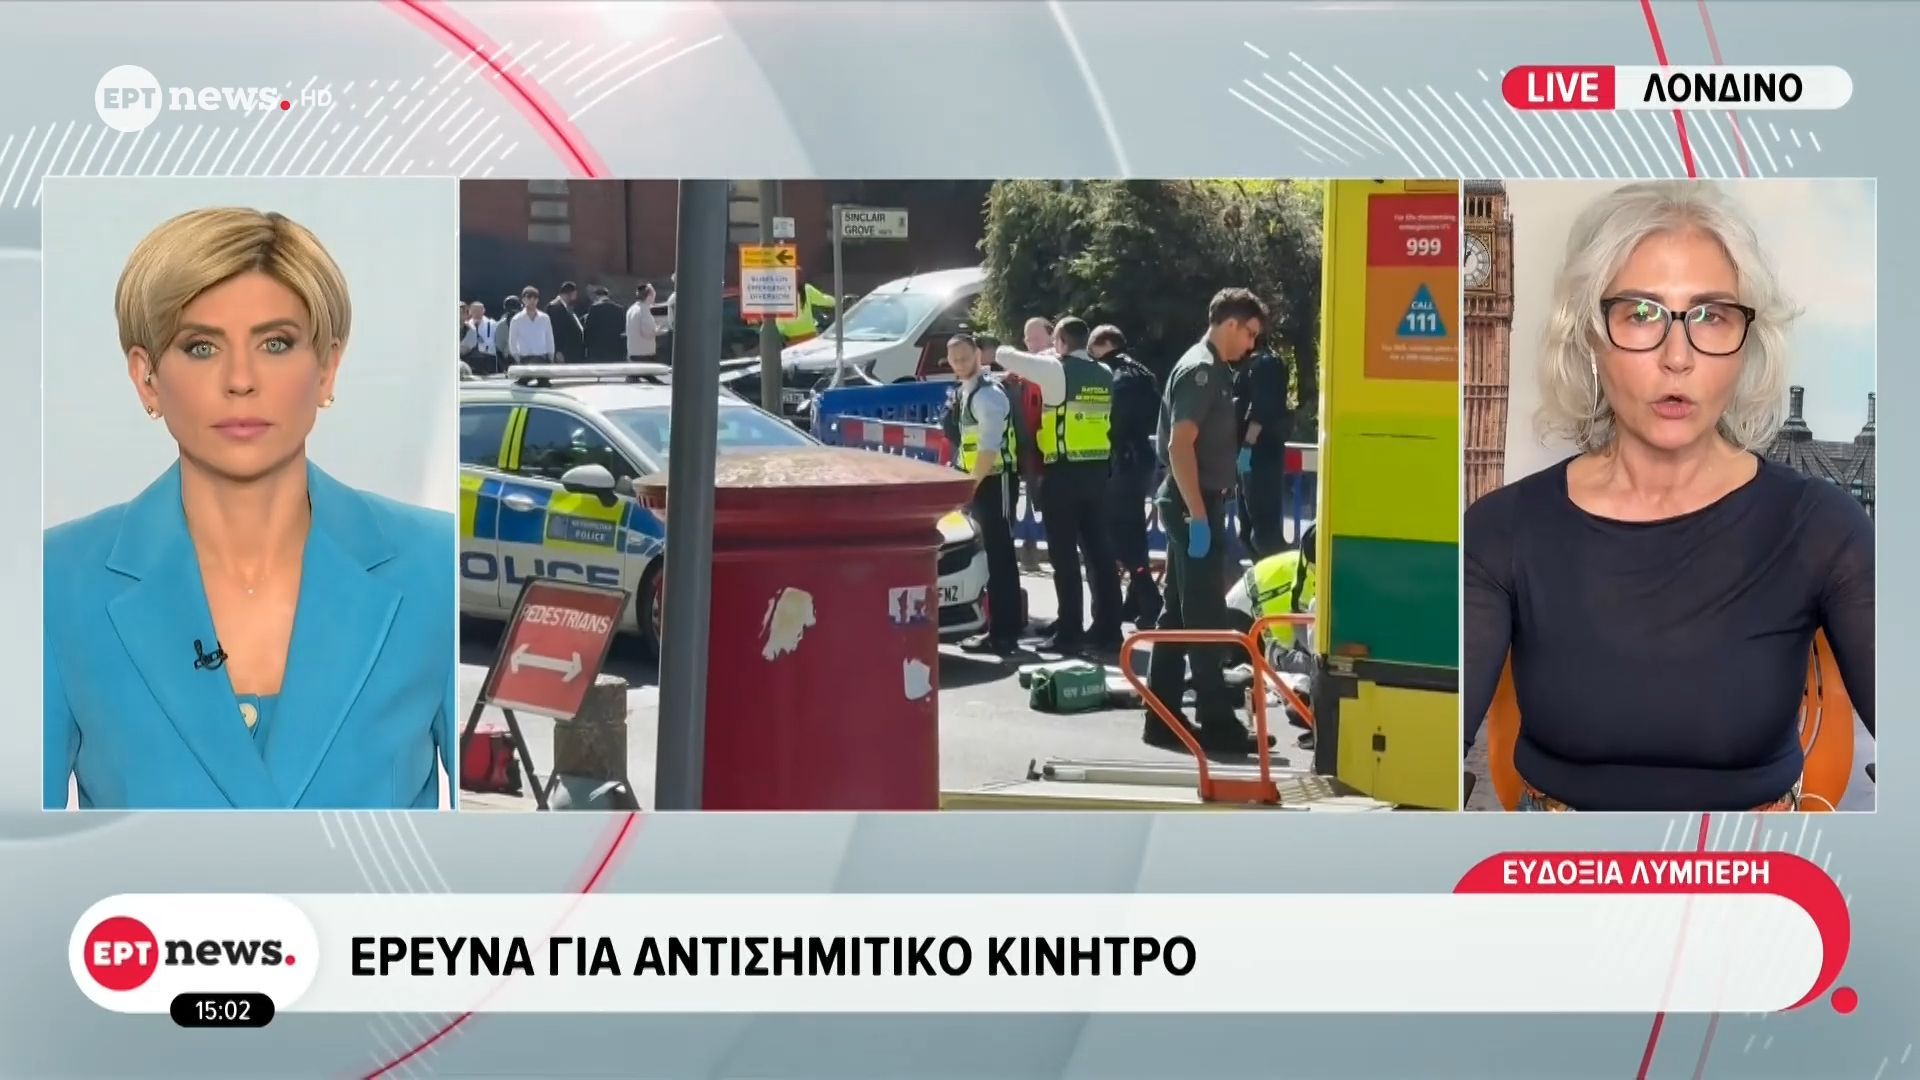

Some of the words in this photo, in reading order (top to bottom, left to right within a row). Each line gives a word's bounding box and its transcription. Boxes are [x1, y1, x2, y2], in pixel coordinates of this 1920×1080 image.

[844, 213, 886, 222] SINCLAIR
[844, 225, 875, 235] GROVE
[1406, 238, 1442, 256] 999
[1411, 301, 1433, 310] CALL
[1406, 313, 1436, 332] 111
[575, 529, 606, 541] POLICE
[519, 603, 611, 634] PEDESTRIANS
